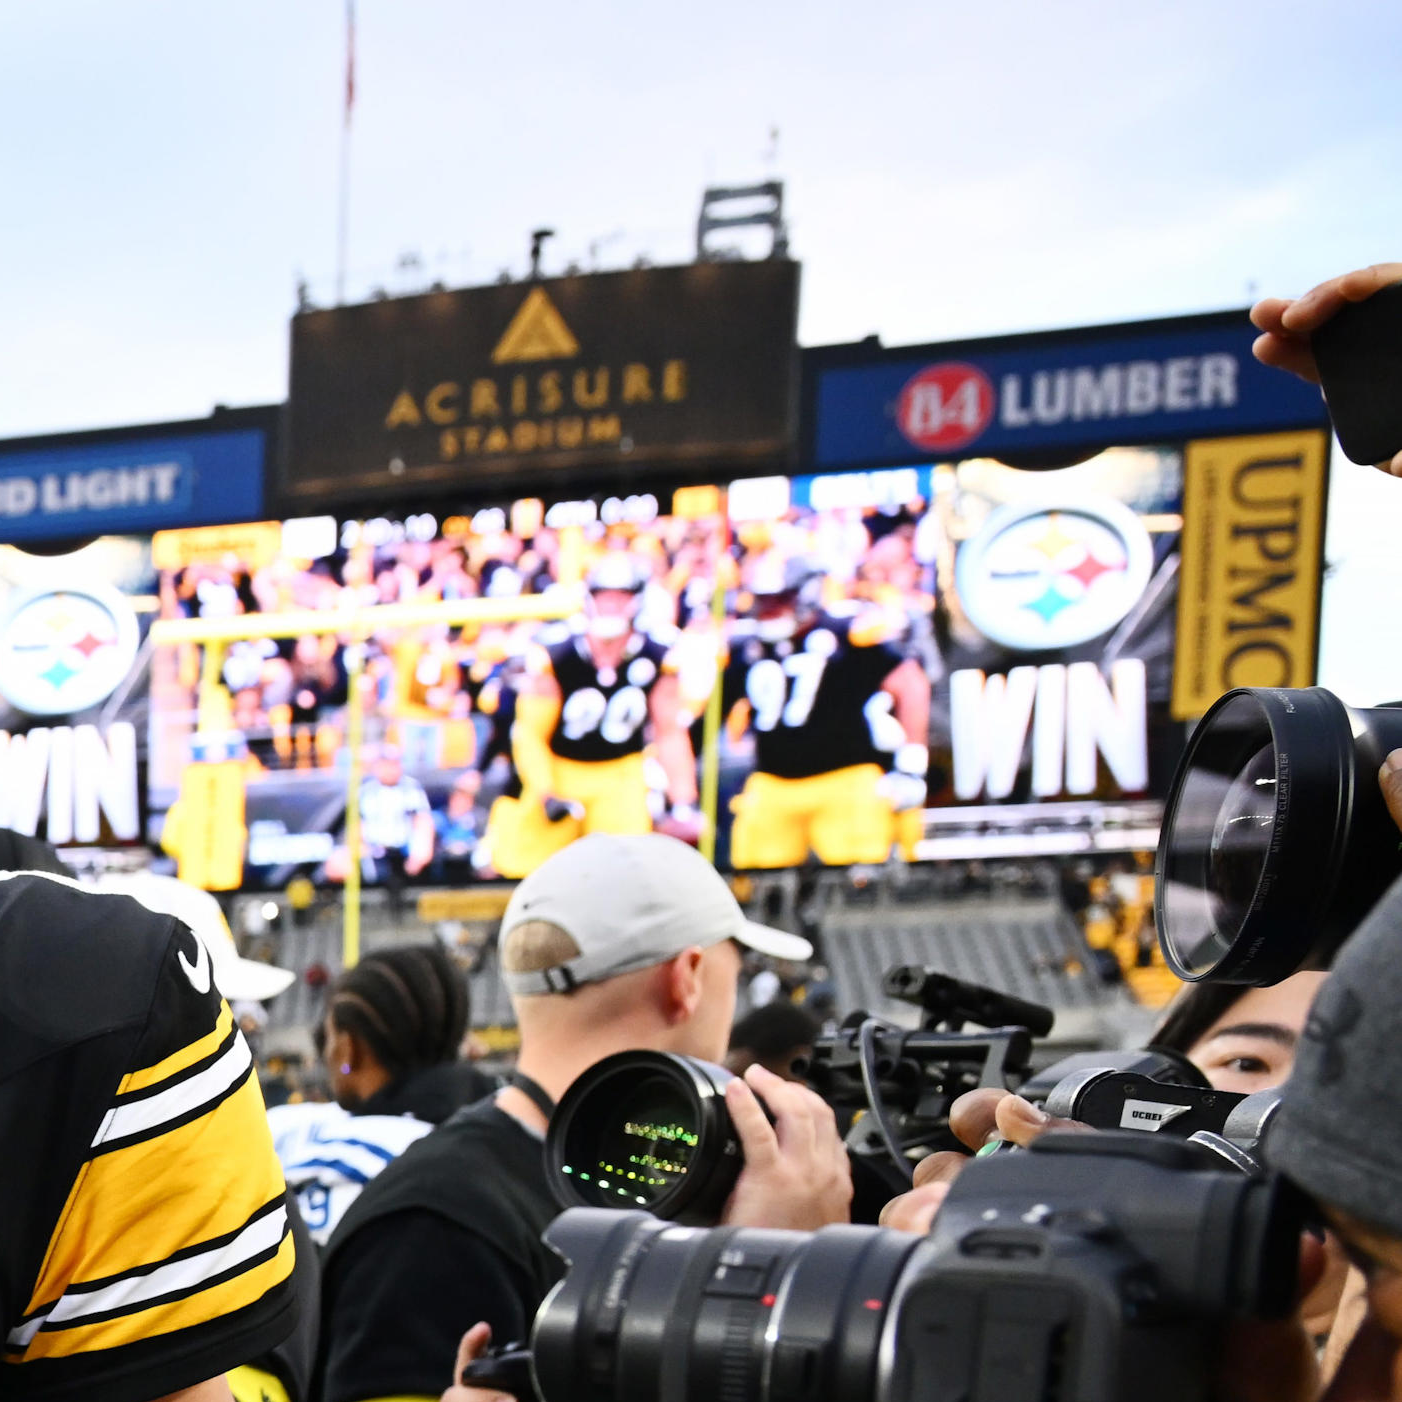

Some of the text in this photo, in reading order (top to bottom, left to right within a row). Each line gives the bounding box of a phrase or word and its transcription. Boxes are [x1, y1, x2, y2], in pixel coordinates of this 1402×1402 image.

[385, 359, 686, 430] ACRISURE
[908, 352, 1239, 438] 84 LUMBER
[439, 412, 622, 462] STADIUM
[40, 462, 181, 514] LIGHT
[1220, 453, 1303, 692] UPMC
[746, 656, 827, 731] 97
[949, 657, 1148, 800] WIN
[1279, 783, 1289, 810] CLEAR
[1280, 753, 1289, 779] FILTER
